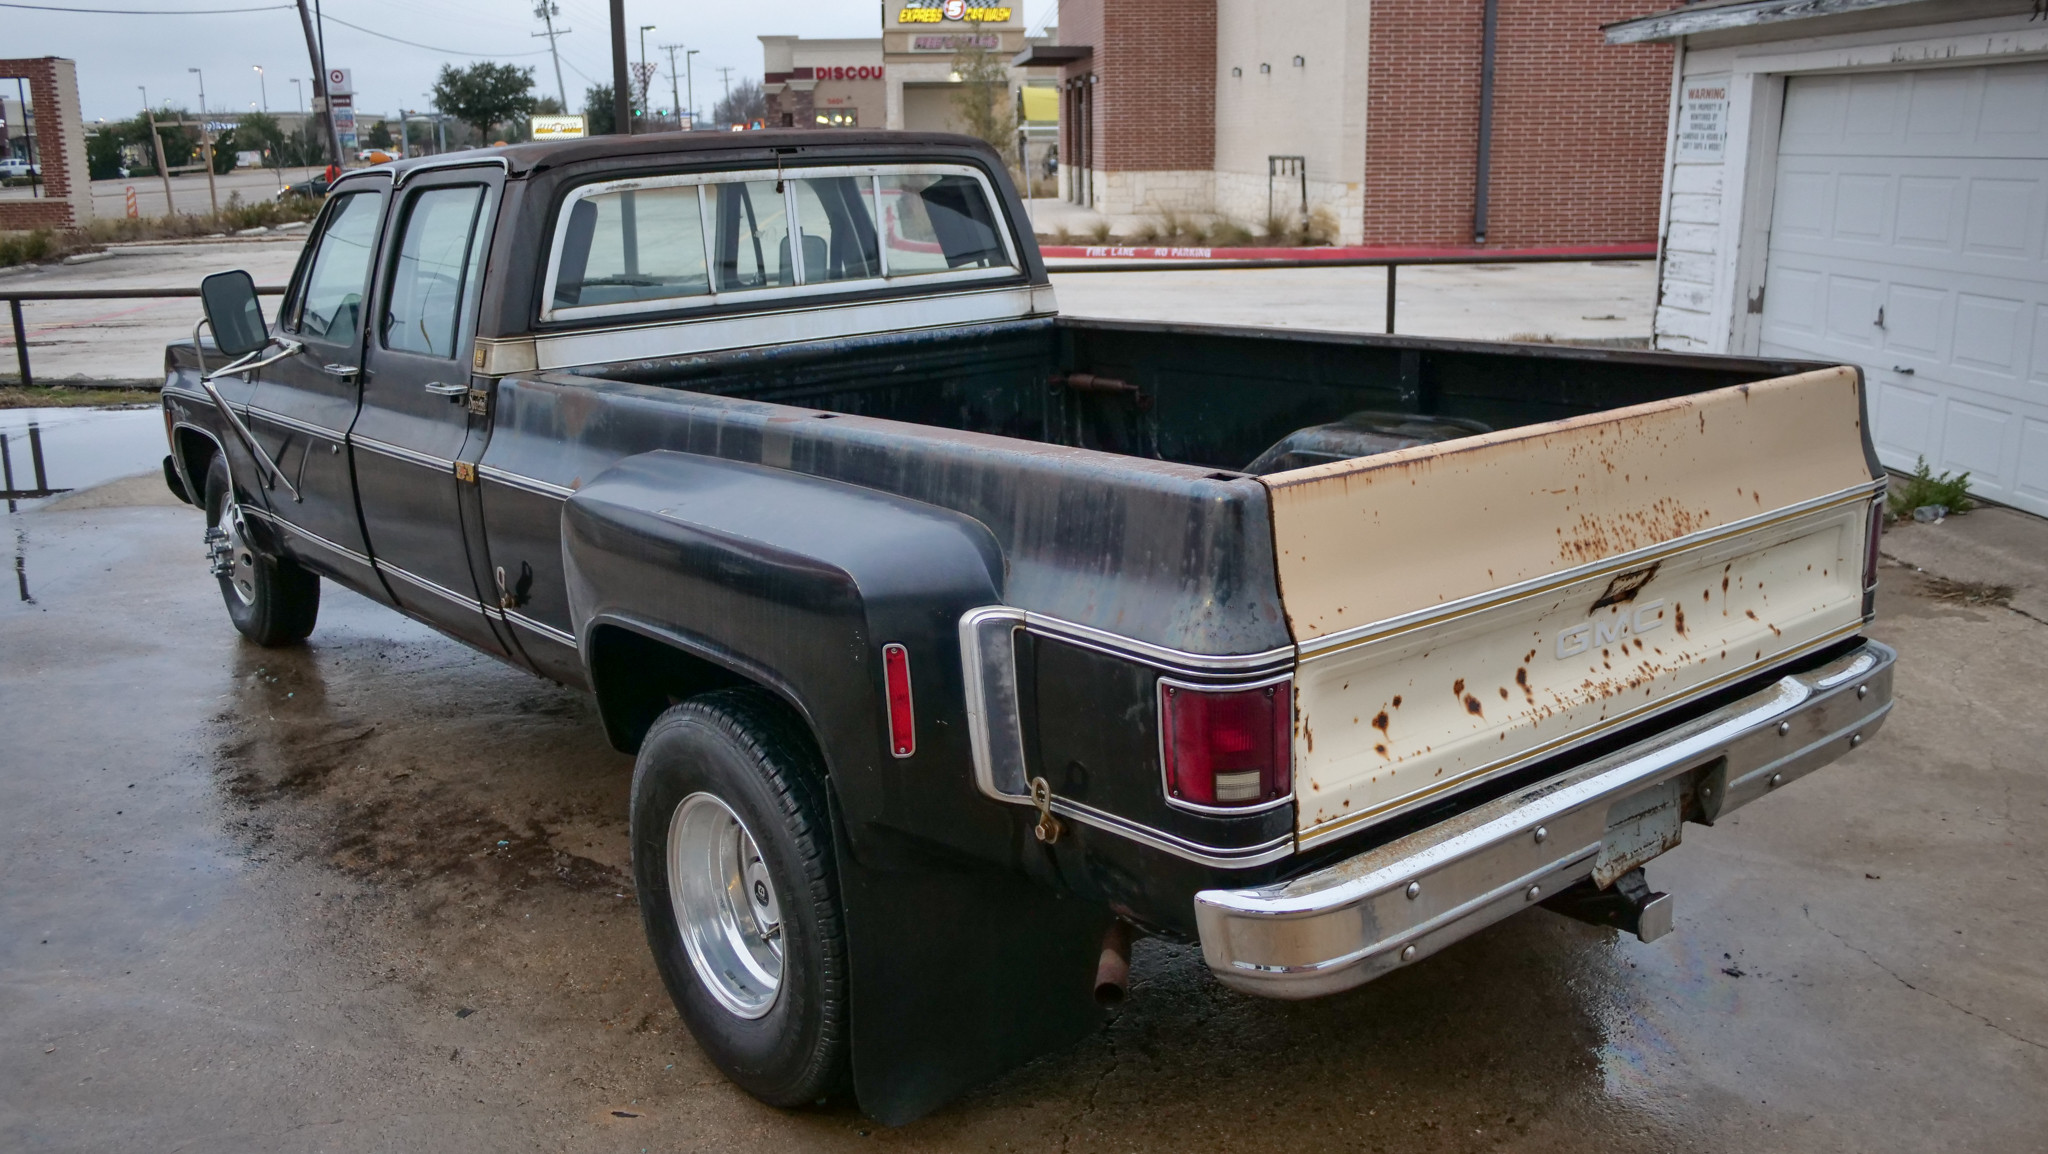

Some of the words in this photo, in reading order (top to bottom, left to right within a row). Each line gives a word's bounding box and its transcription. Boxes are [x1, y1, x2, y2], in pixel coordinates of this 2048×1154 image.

[898, 8, 943, 23] EXPRESS
[948, 0, 963, 16] 5
[983, 7, 1012, 22] WASH
[815, 66, 883, 80] DISCOU
[1688, 88, 1725, 100] WARNING
[1086, 247, 1107, 257] FIRE
[1111, 247, 1135, 257] LANE
[1154, 247, 1169, 257] NO
[1171, 247, 1212, 258] PARKING
[1556, 598, 1665, 660] GMC
